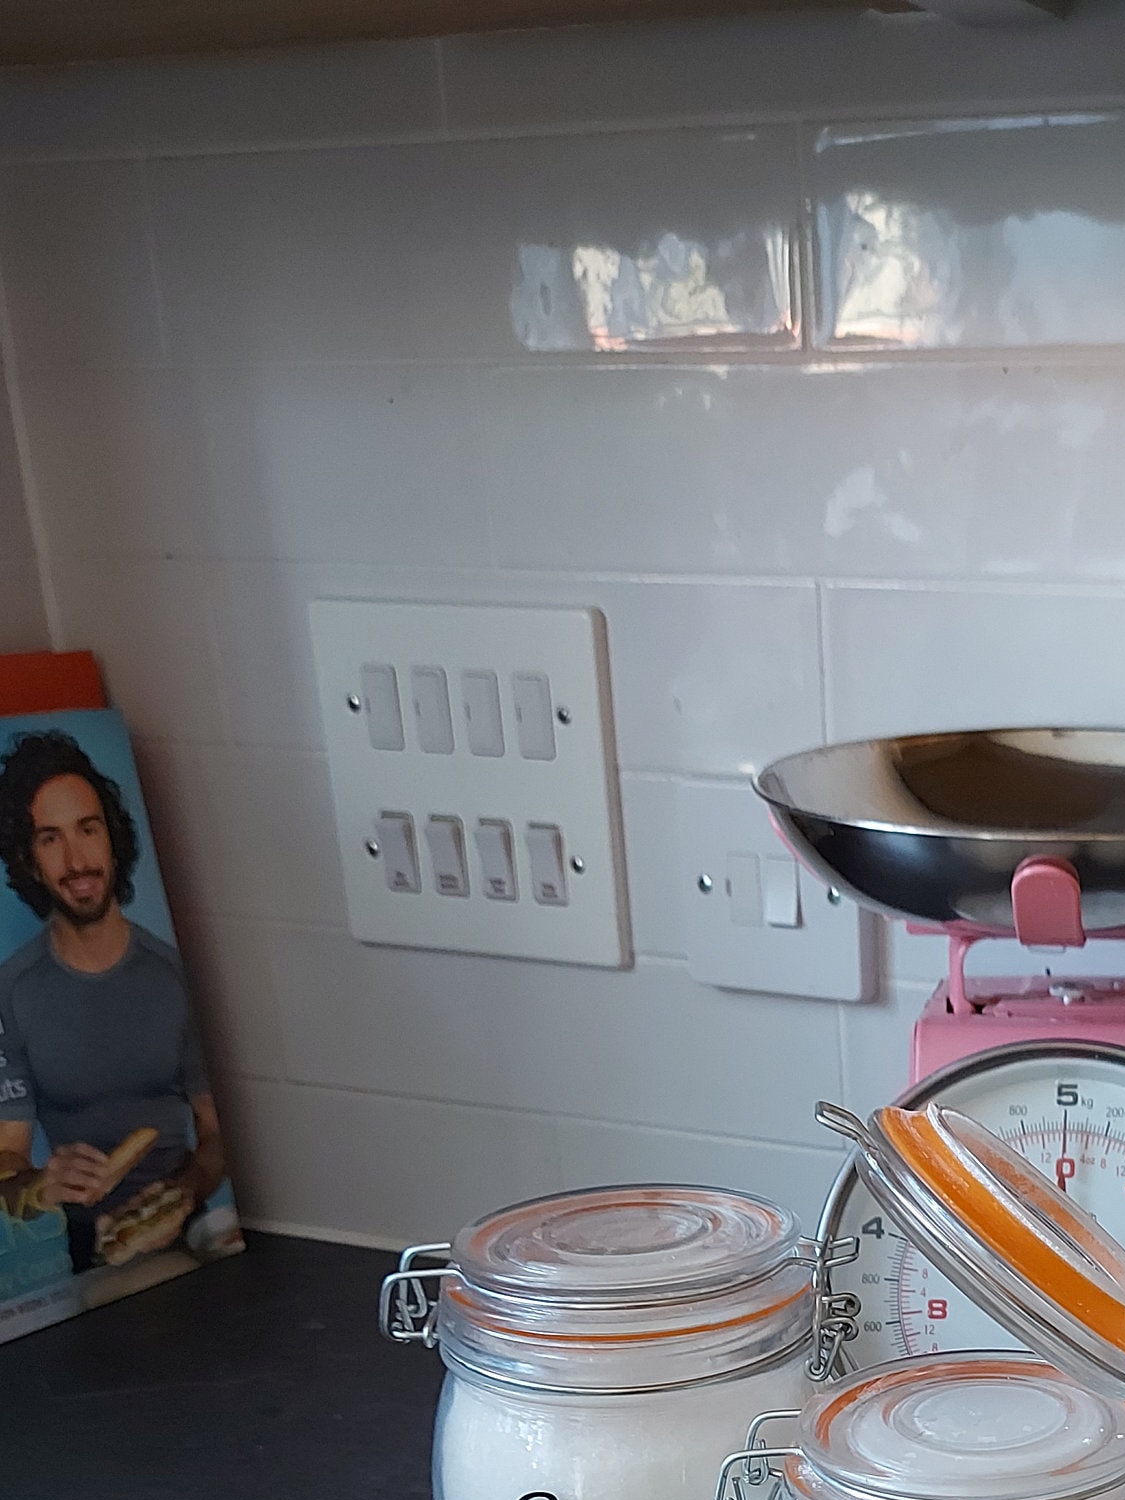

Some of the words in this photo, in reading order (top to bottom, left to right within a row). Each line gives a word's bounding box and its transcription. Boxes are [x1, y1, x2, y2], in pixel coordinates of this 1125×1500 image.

[1056, 1084, 1079, 1106] 5
[1081, 1096, 1094, 1109] kg
[1009, 1105, 1027, 1116] 800
[1040, 1153, 1051, 1164] 12
[862, 1216, 885, 1239] 4
[861, 1273, 880, 1284] 800
[922, 1268, 928, 1279] 8
[920, 1287, 926, 1297] 4
[927, 1299, 947, 1320] 8
[863, 1321, 882, 1332] 600
[924, 1324, 935, 1335] 12
